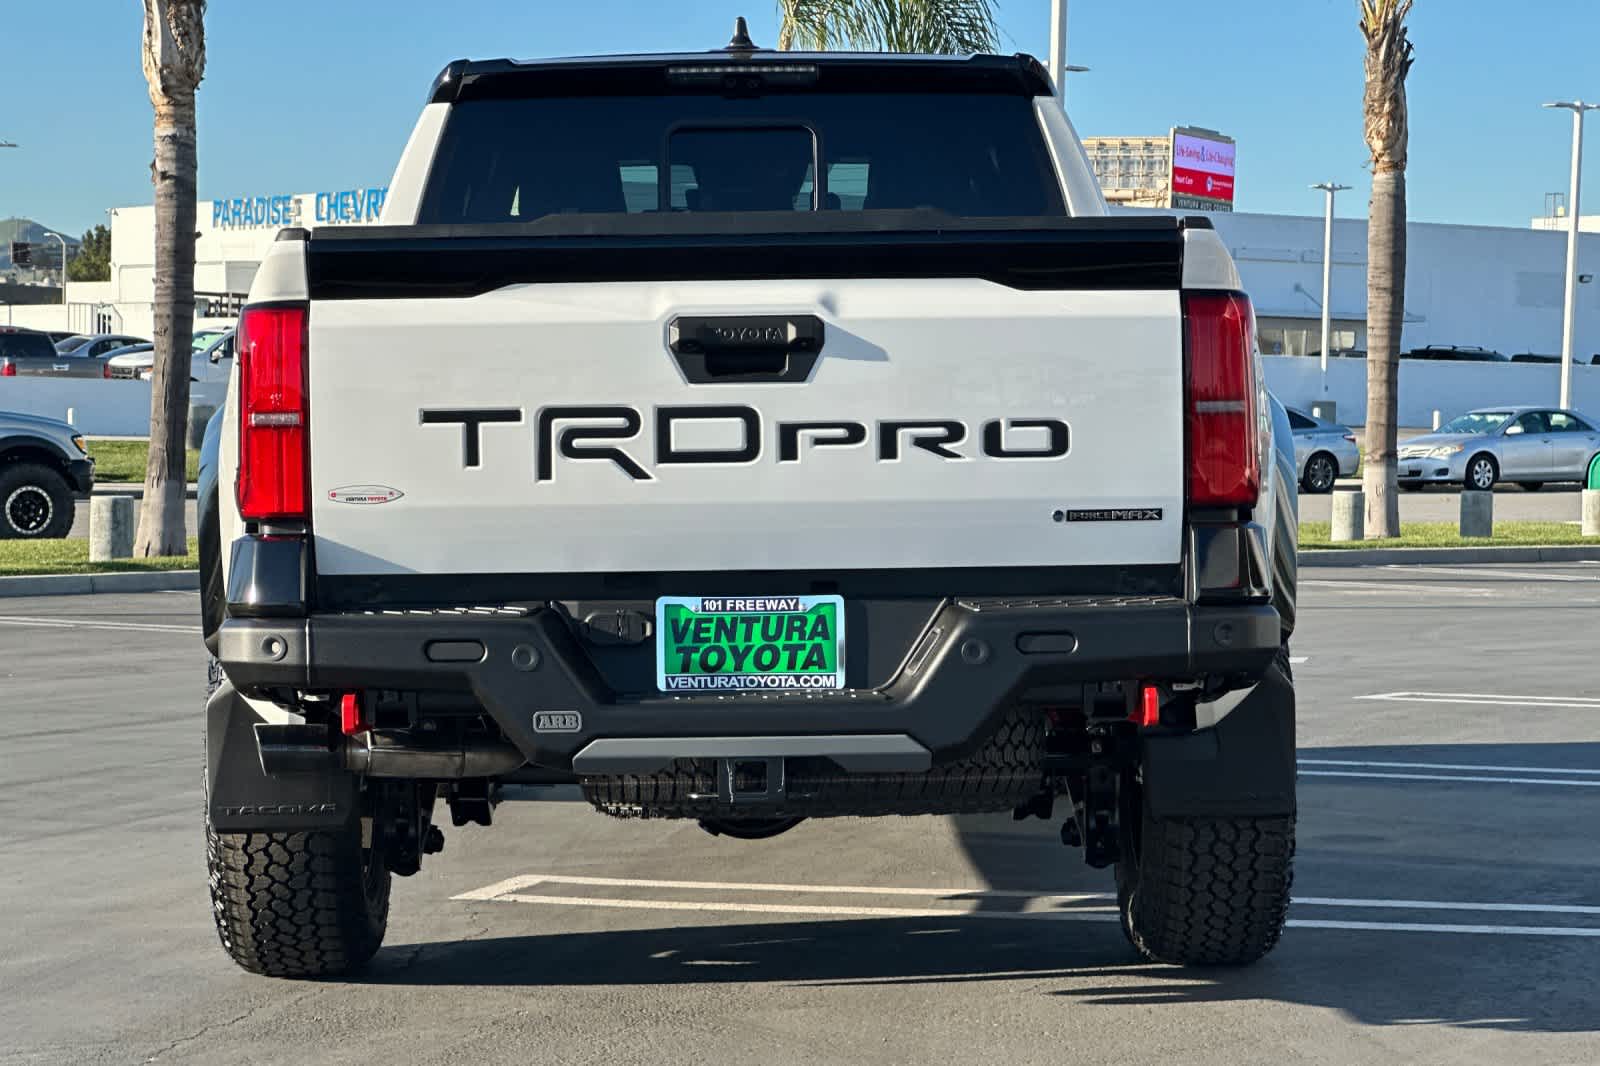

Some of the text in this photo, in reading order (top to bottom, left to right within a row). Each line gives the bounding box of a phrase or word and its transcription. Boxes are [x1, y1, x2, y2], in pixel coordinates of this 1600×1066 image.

[212, 195, 293, 229] PARADISE
[420, 405, 1071, 482] TRD PRO
[703, 598, 797, 611] 101 FREEWAY
[670, 614, 830, 644] VENTURA
[676, 642, 827, 673] TOYOTA
[667, 675, 836, 689] VENTURATOYOTA.COM
[538, 714, 578, 729] ARB
